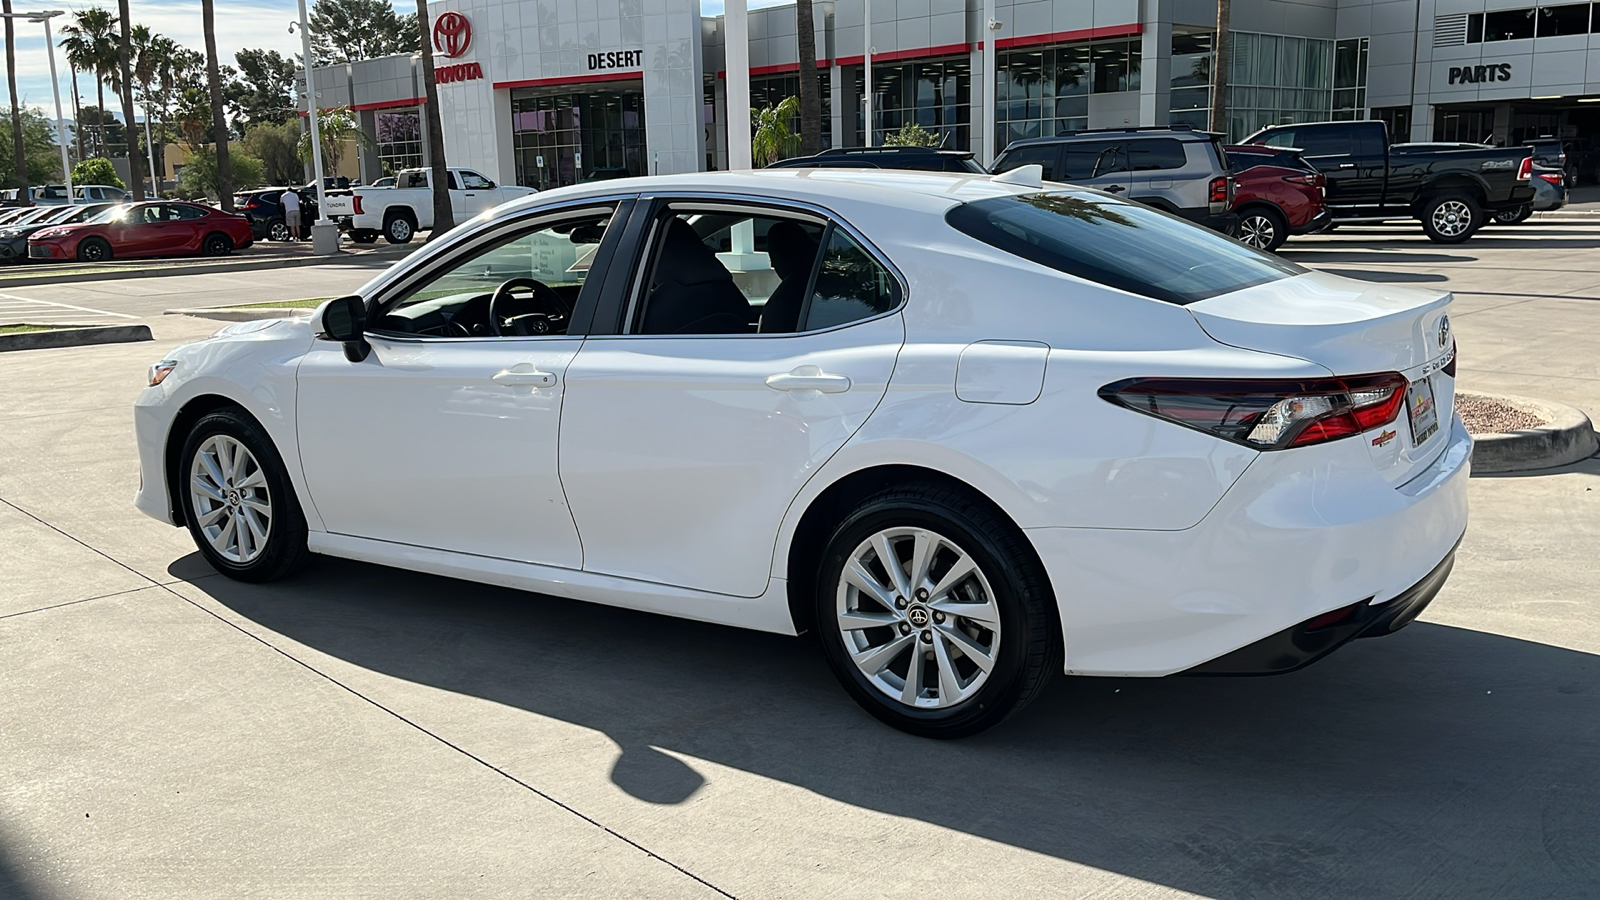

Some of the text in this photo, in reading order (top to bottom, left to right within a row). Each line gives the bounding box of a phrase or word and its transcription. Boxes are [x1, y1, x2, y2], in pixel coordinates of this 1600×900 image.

[587, 49, 643, 71] DESERT
[434, 62, 484, 85] TOYOTA
[1448, 63, 1512, 85] PARTS
